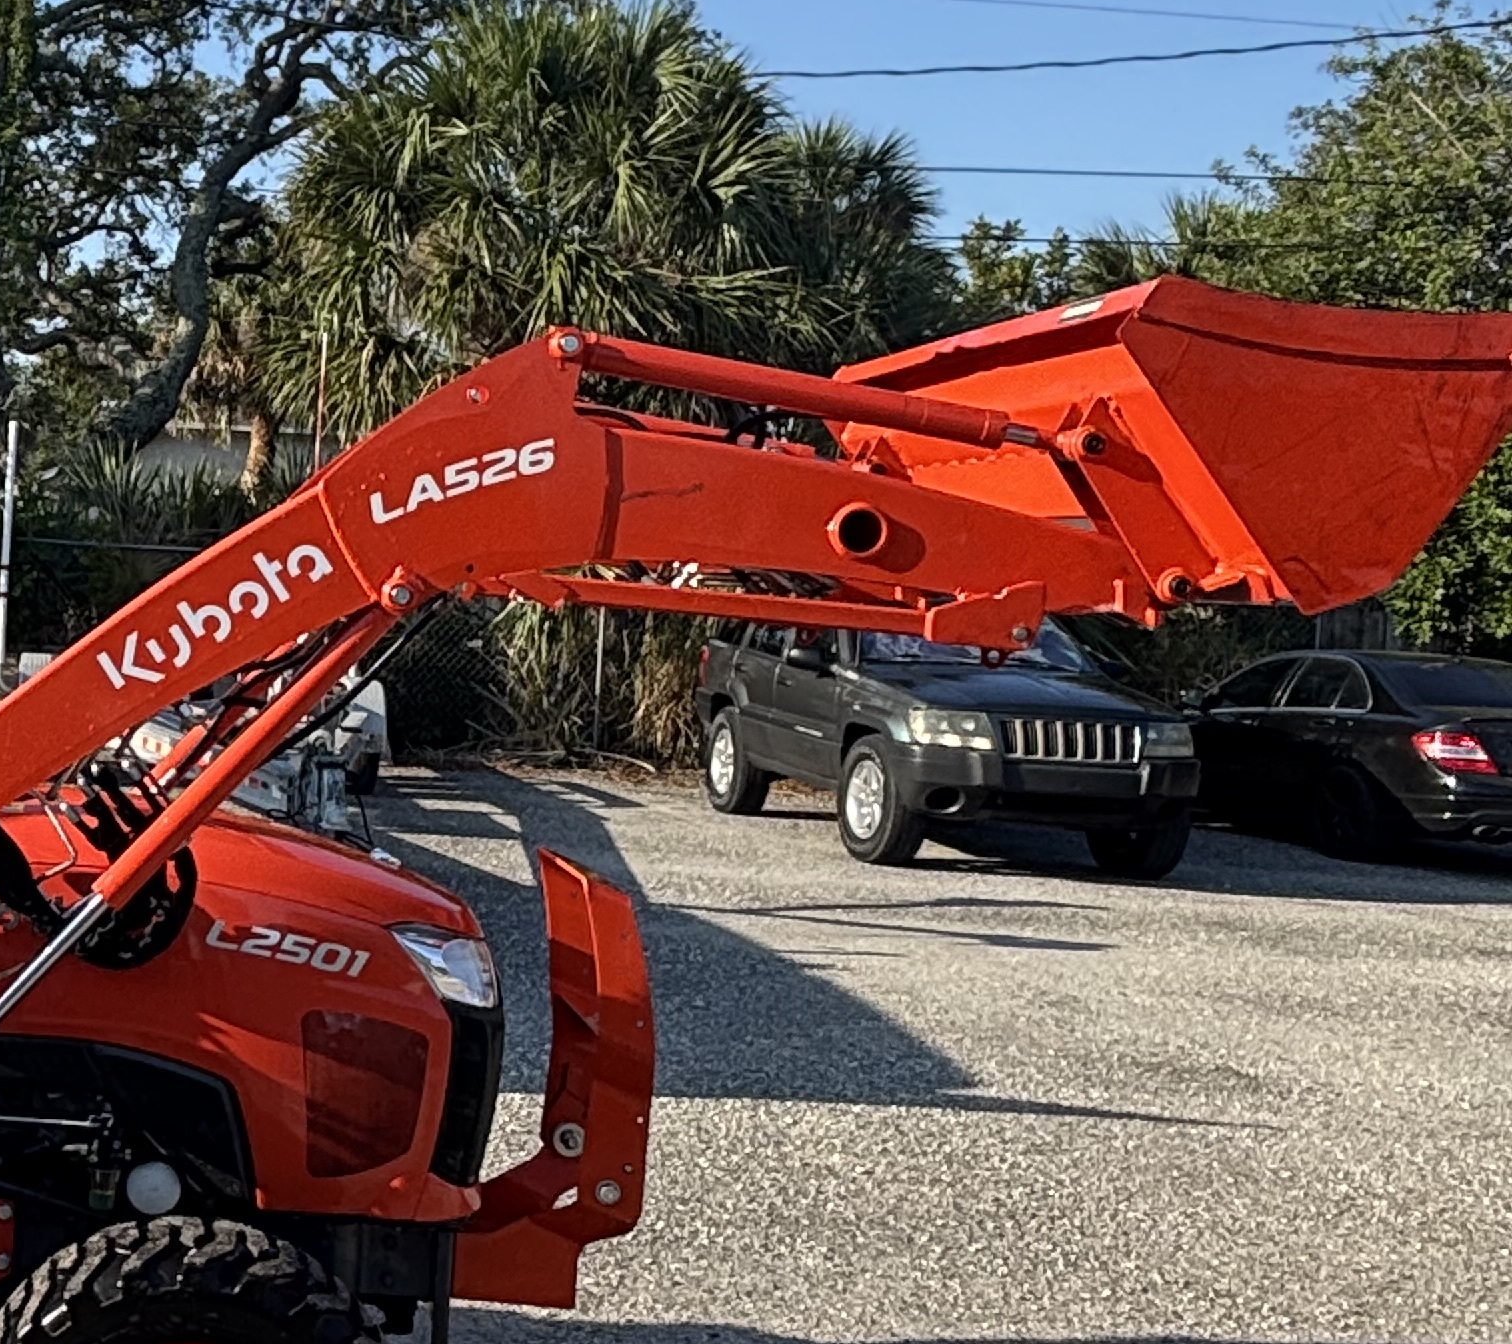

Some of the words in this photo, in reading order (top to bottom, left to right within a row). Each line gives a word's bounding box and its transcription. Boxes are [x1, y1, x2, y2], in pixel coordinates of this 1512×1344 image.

[369, 438, 556, 524] LA526
[97, 544, 334, 690] Kubota
[205, 919, 372, 978] L2501
